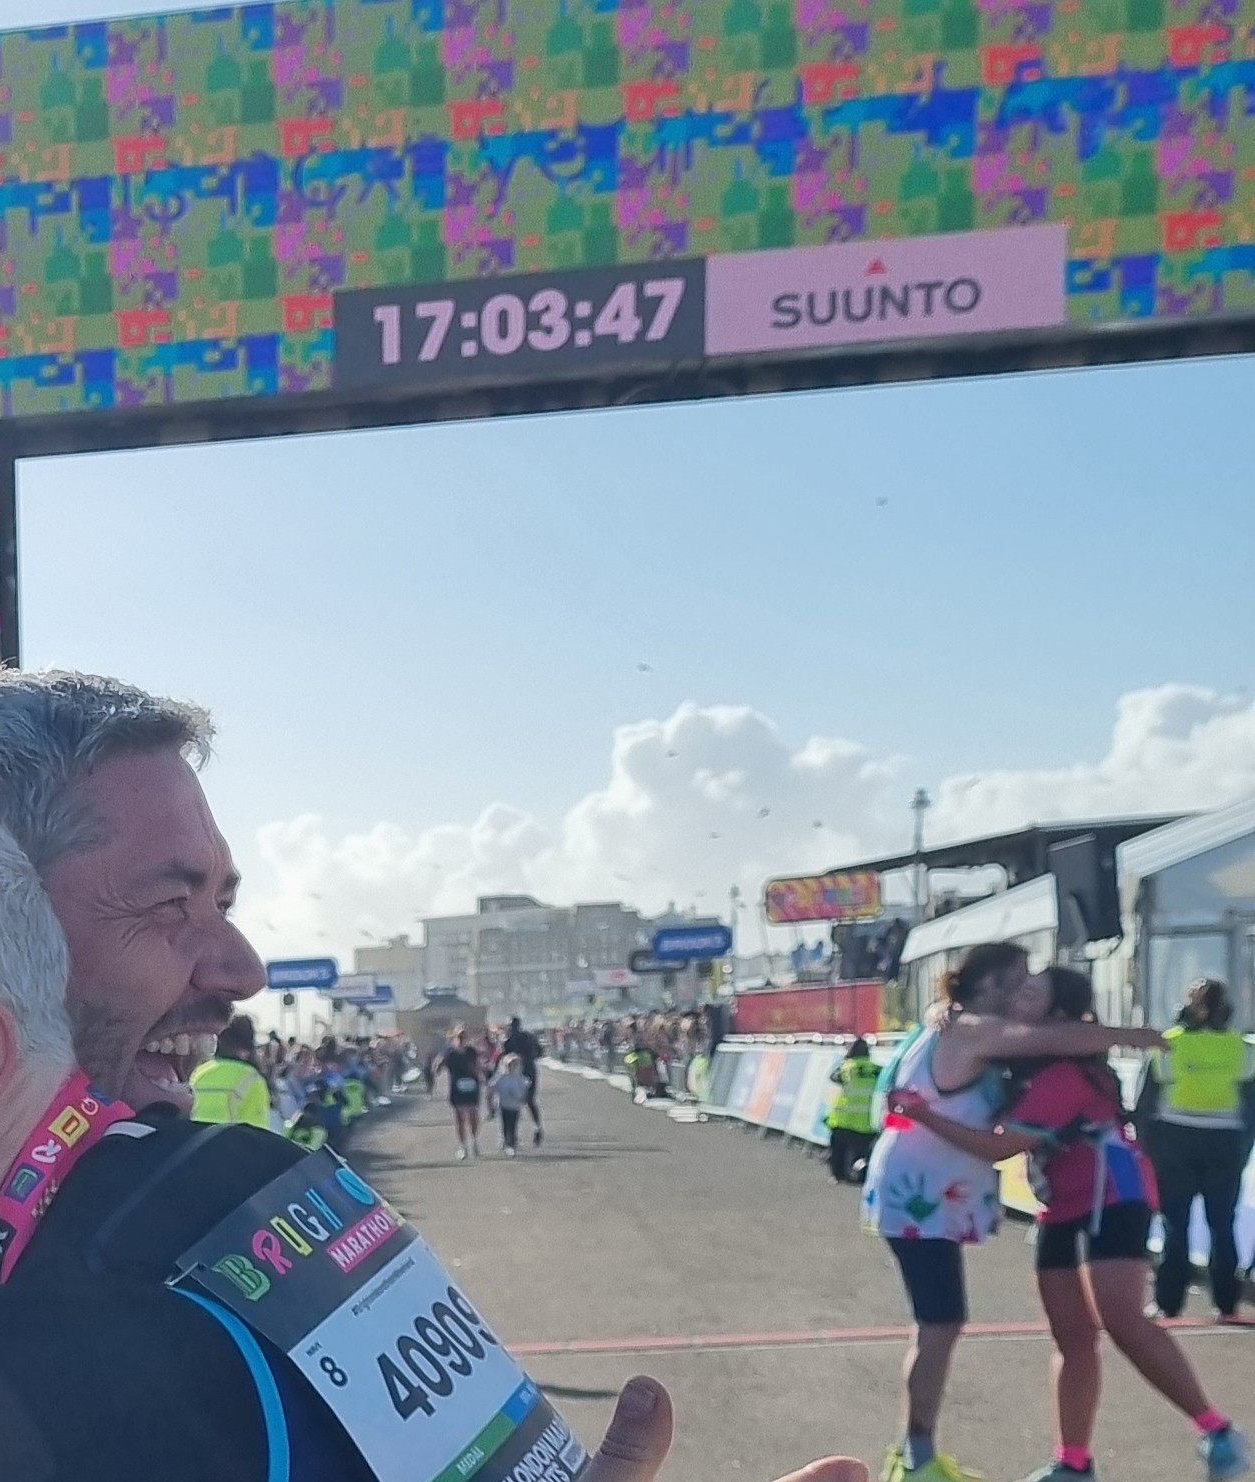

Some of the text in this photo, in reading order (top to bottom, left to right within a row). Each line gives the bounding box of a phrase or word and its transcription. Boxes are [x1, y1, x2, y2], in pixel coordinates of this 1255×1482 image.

[373, 277, 685, 366] 17:03:47
[770, 277, 982, 330] SUUNTO
[319, 1355, 349, 1388] 8
[376, 1285, 500, 1422] 40909
